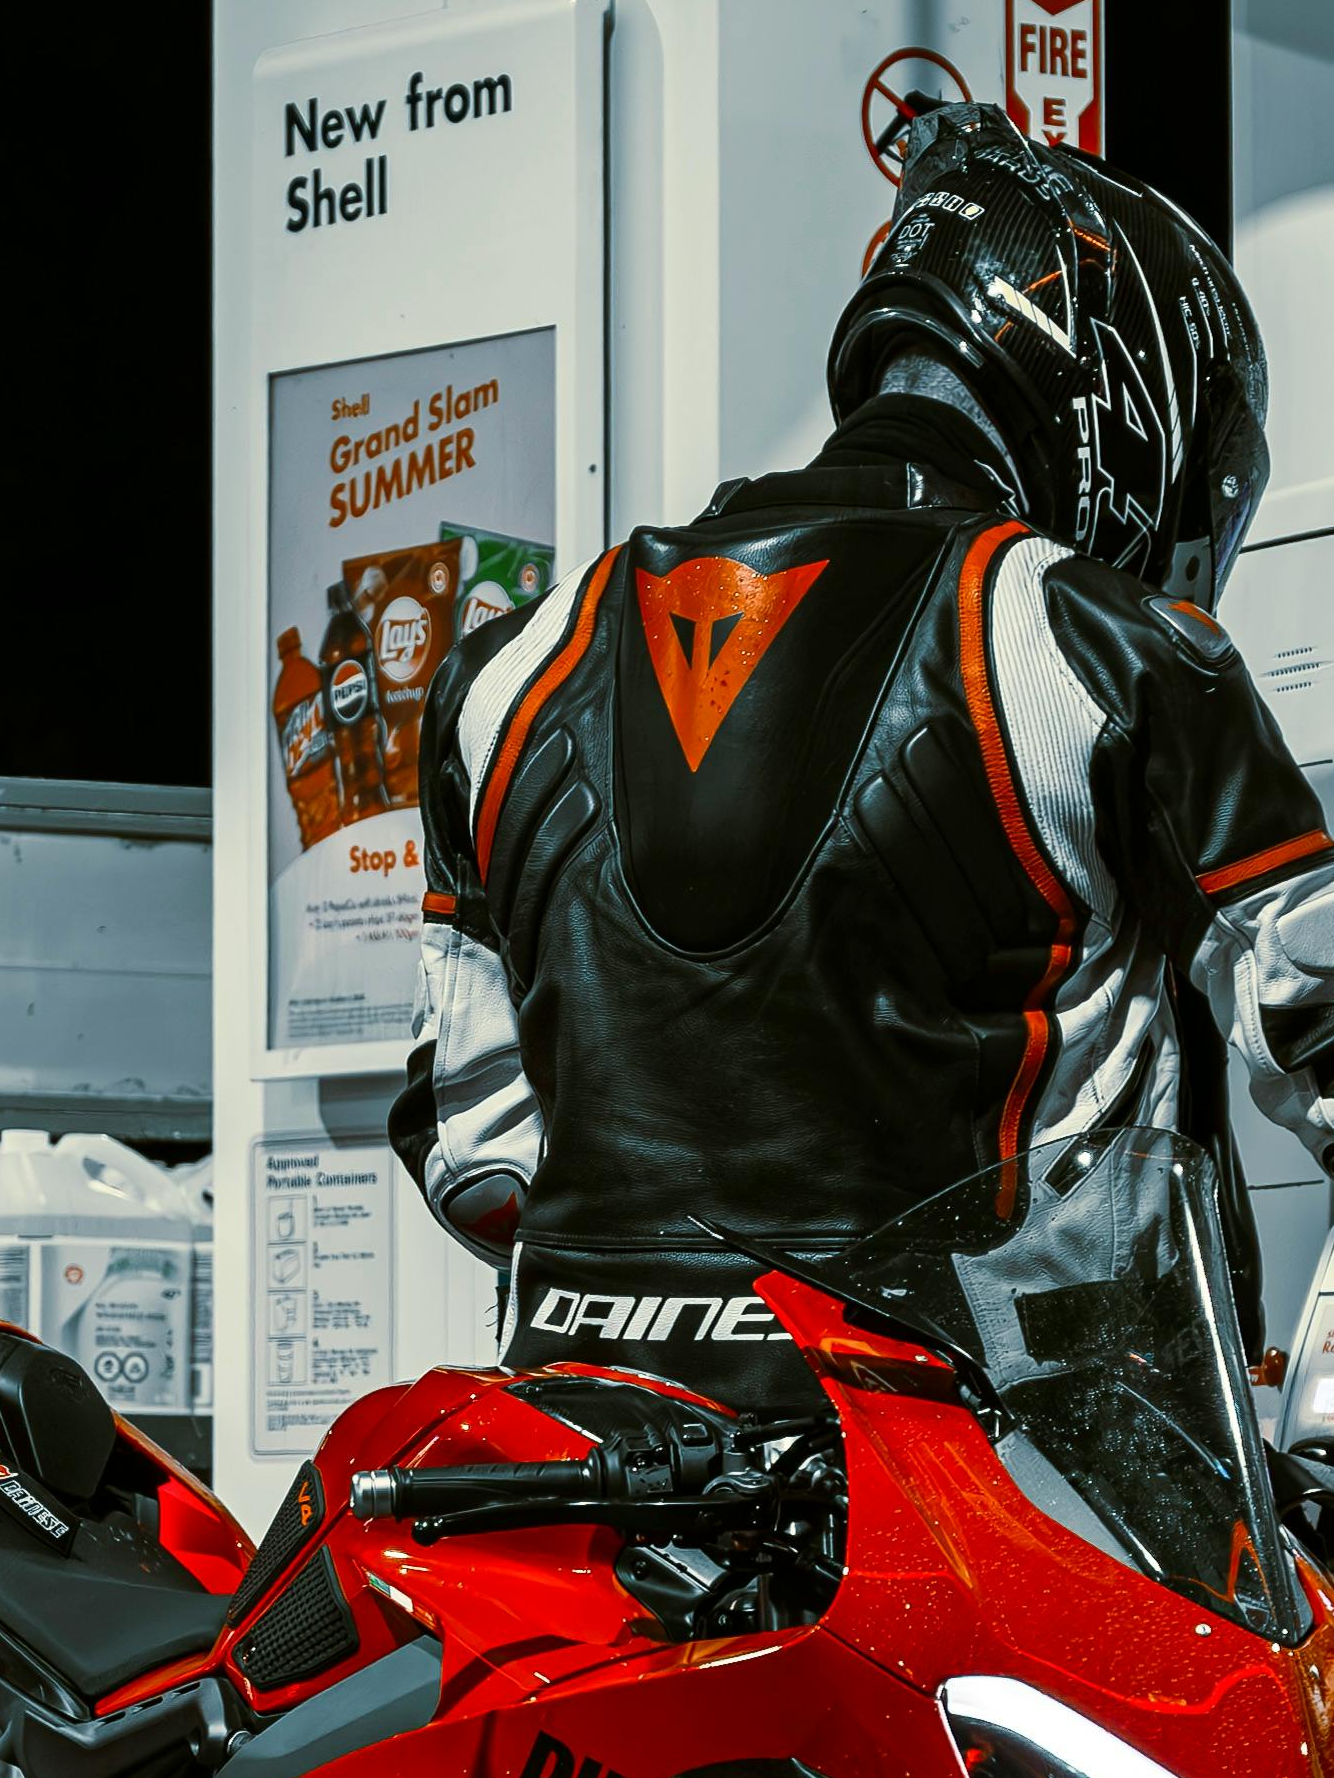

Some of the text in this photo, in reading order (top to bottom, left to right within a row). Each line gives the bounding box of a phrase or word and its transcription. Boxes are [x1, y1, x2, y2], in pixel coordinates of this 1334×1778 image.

[1019, 23, 1088, 79] FIRE
[284, 71, 513, 158] New from
[285, 154, 388, 234] Shell
[899, 222, 934, 238] DOT
[329, 378, 499, 475] Grand Slam
[331, 393, 370, 421] Shell
[328, 427, 477, 529] SUMMER
[1072, 397, 1092, 541] PRO
[379, 616, 429, 664] Lay's
[350, 839, 420, 878] Stop &
[530, 1287, 794, 1341] DAINE
